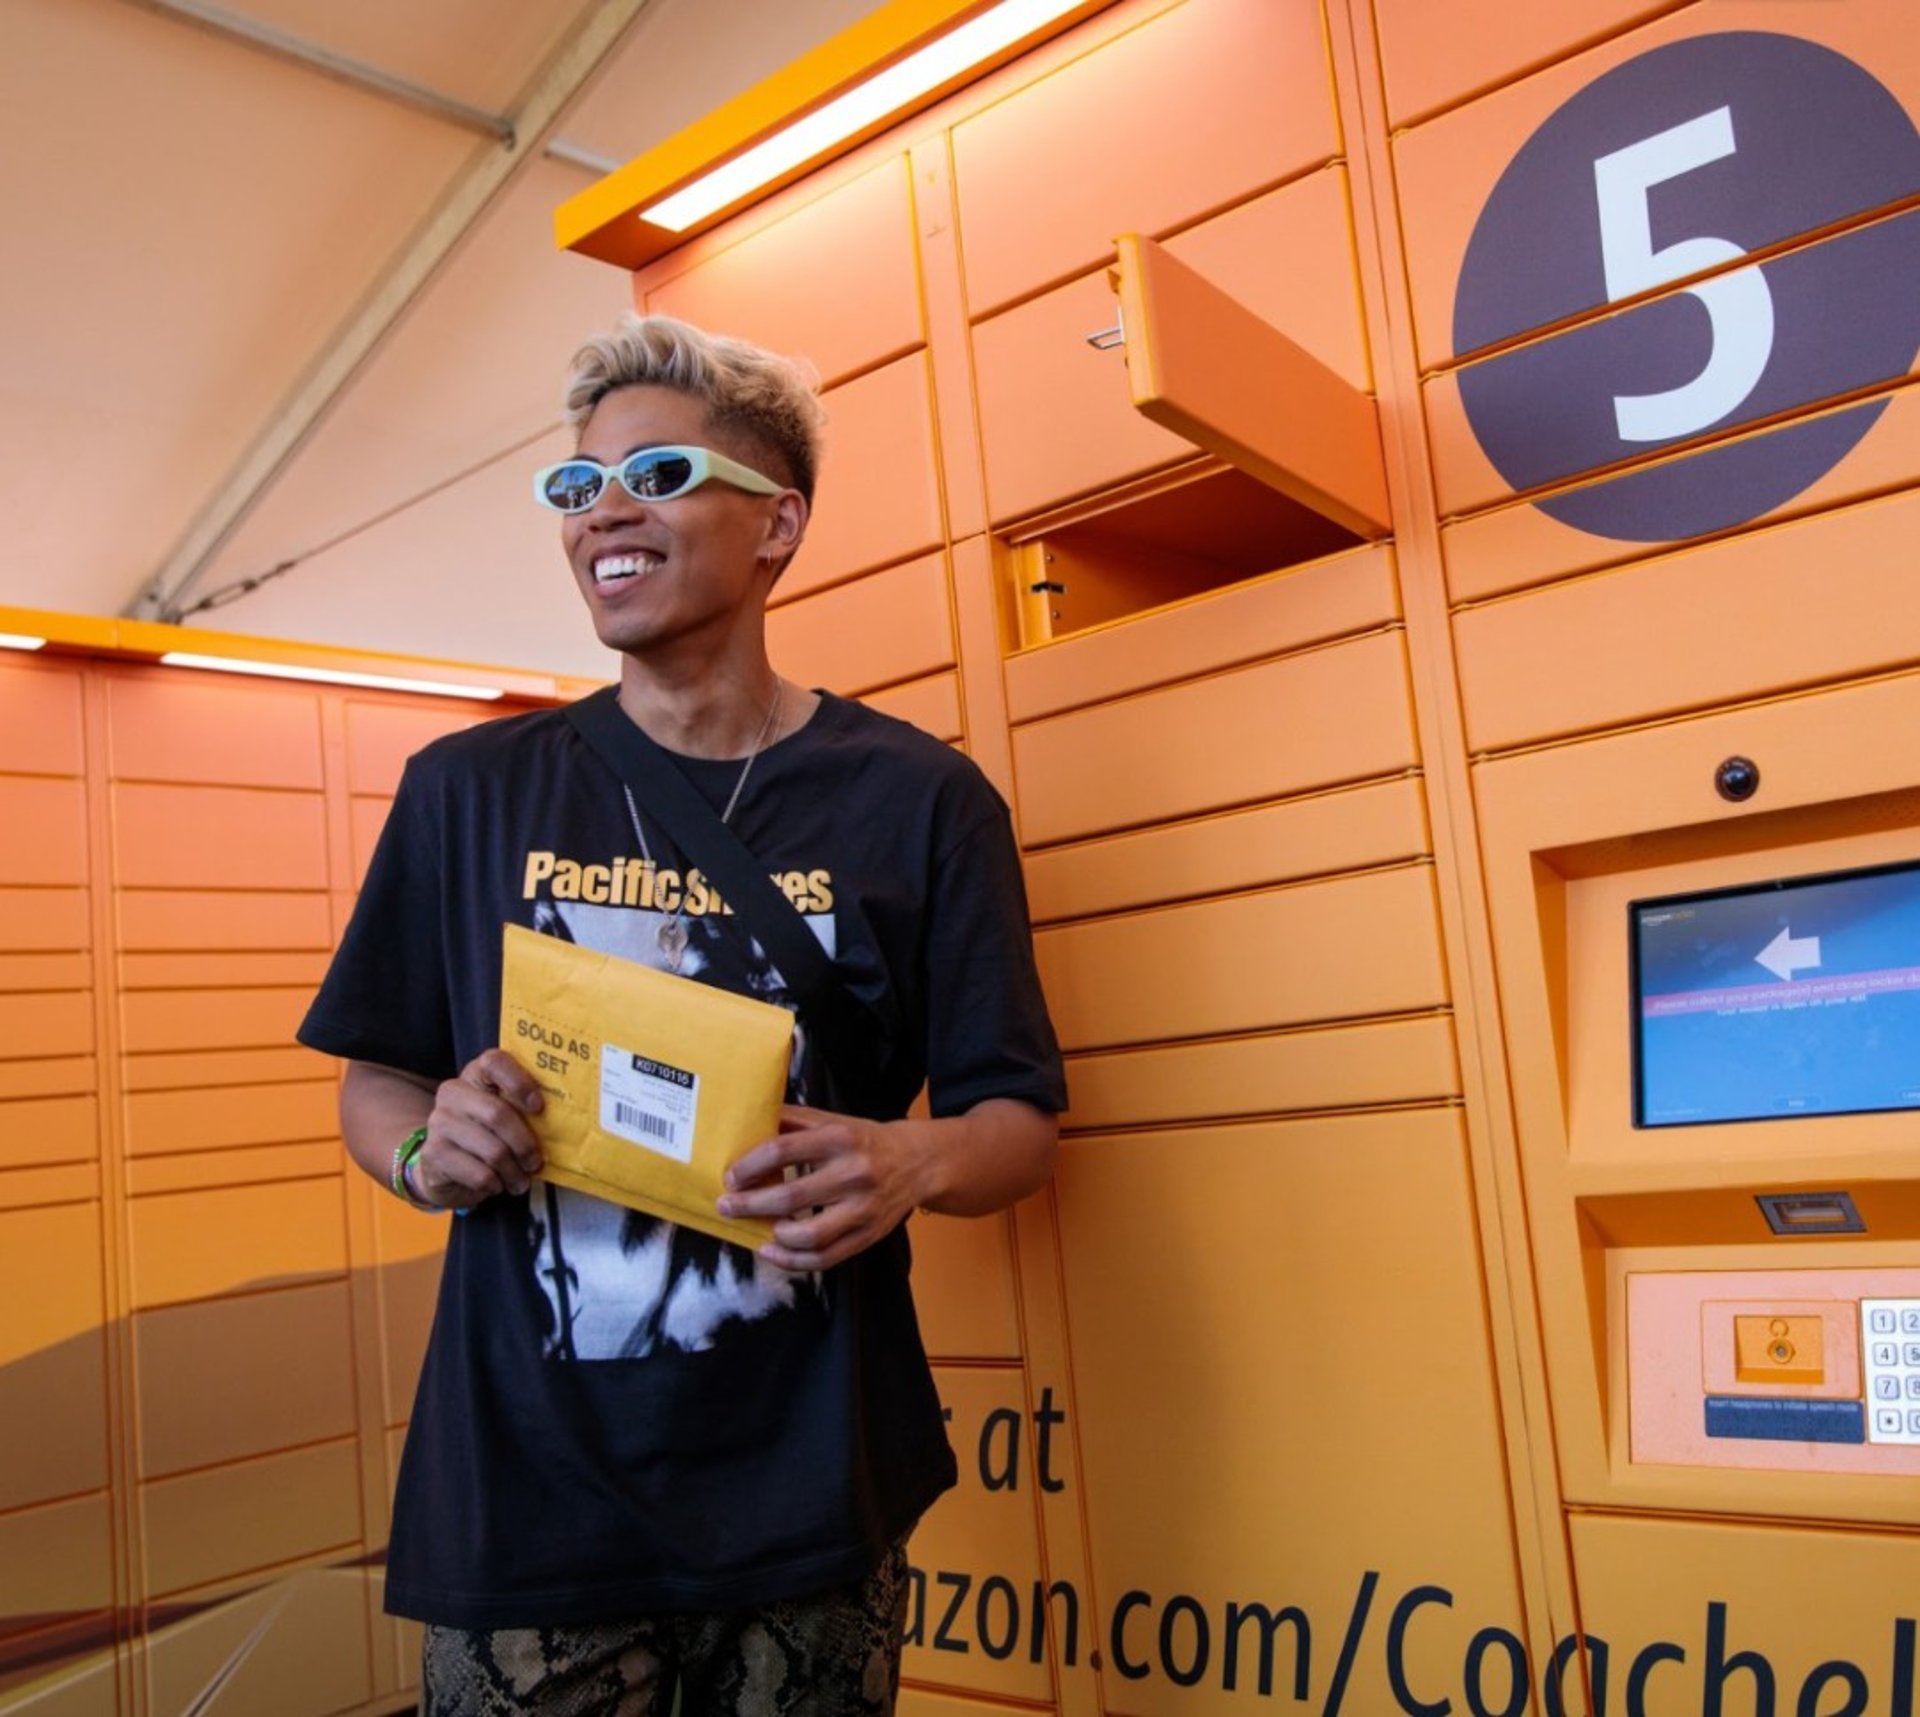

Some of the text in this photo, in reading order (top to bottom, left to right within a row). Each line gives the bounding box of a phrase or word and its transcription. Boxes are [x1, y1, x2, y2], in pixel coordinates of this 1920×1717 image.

[1594, 105, 1774, 442] 5
[523, 851, 834, 916] Pacific Ses
[517, 1019, 590, 1060] SOLD AS
[536, 1050, 569, 1075] SET
[1908, 1313, 1918, 1329] 2
[1880, 1347, 1920, 1361] 4 5
[1882, 1380, 1891, 1395] 7
[978, 1387, 1065, 1493] at
